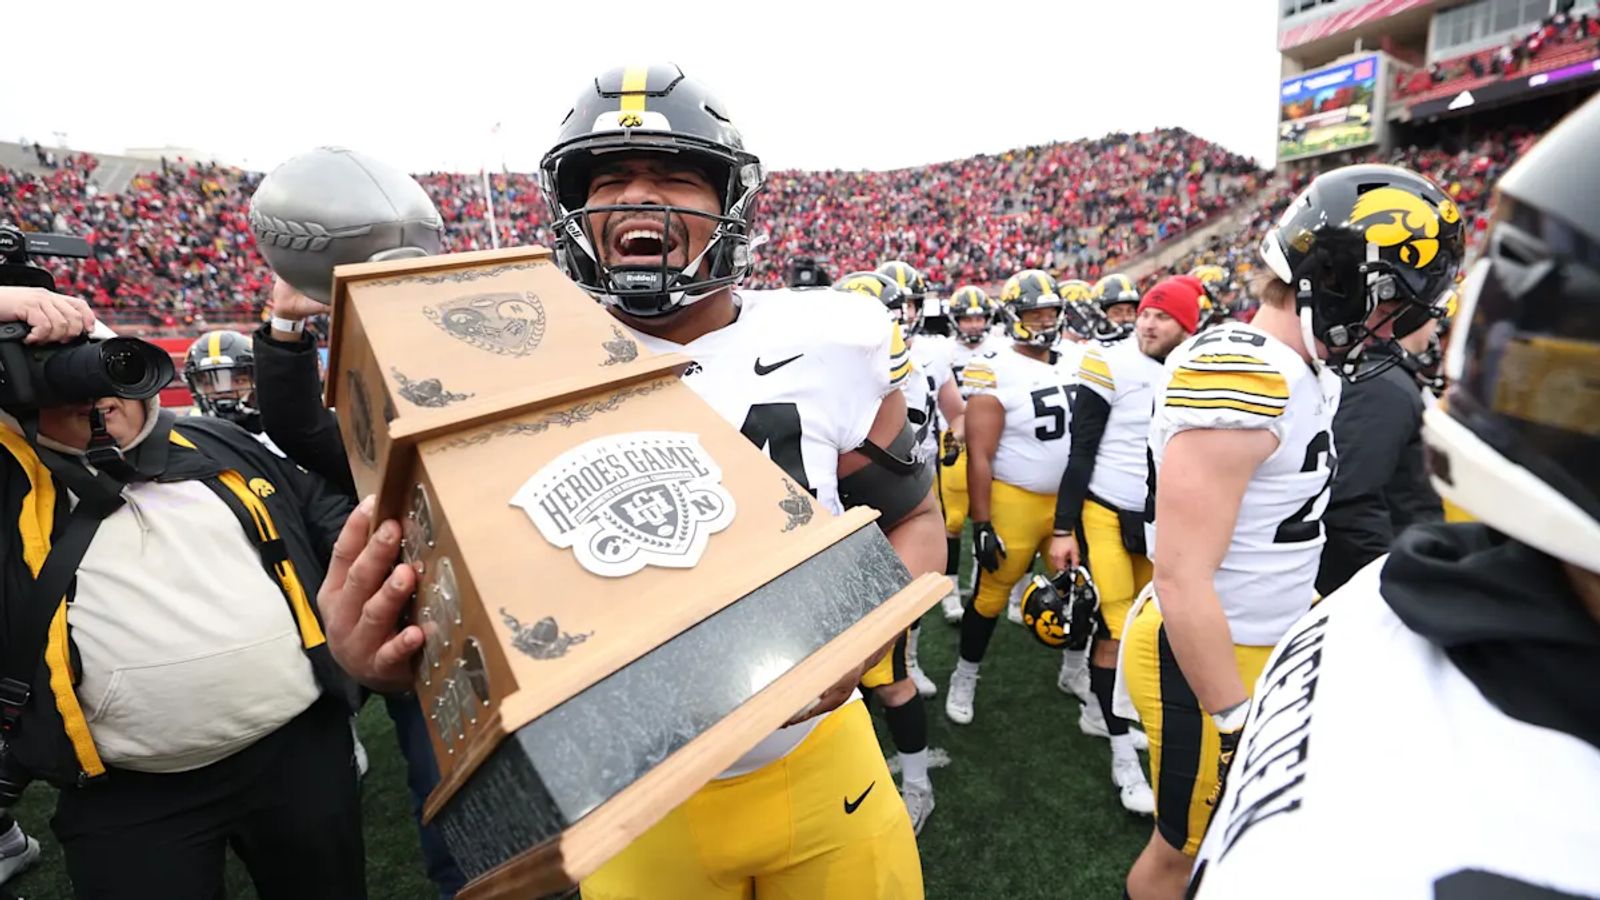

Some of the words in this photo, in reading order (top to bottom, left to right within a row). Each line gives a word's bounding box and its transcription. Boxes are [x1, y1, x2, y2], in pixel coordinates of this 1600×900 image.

[538, 452, 630, 535] HEROES
[625, 445, 710, 478] GAME
[691, 494, 718, 516] N
